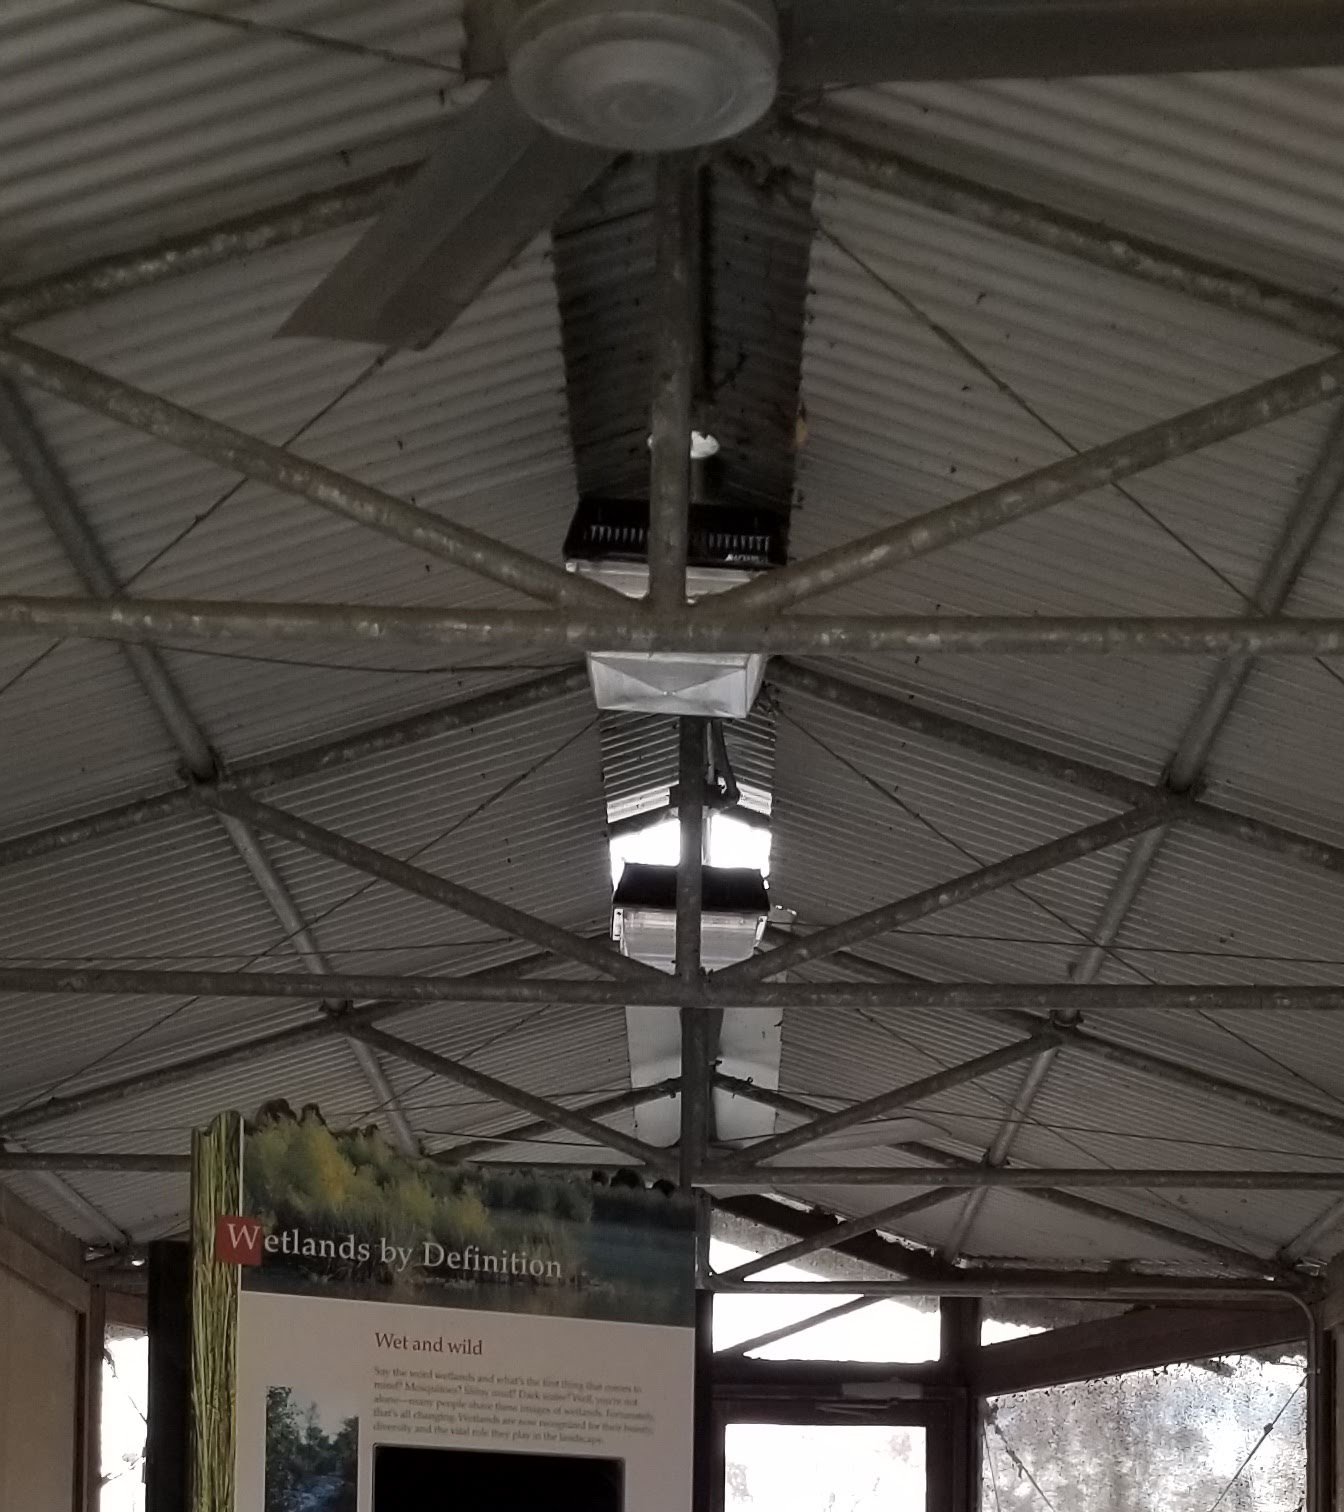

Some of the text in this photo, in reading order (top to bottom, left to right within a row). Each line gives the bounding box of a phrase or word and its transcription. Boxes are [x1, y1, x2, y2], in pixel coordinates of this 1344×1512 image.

[226, 1222, 562, 1279] Wetlands by Definition
[375, 1332, 482, 1355] Wet and wild
[435, 1371, 475, 1382] wetlands
